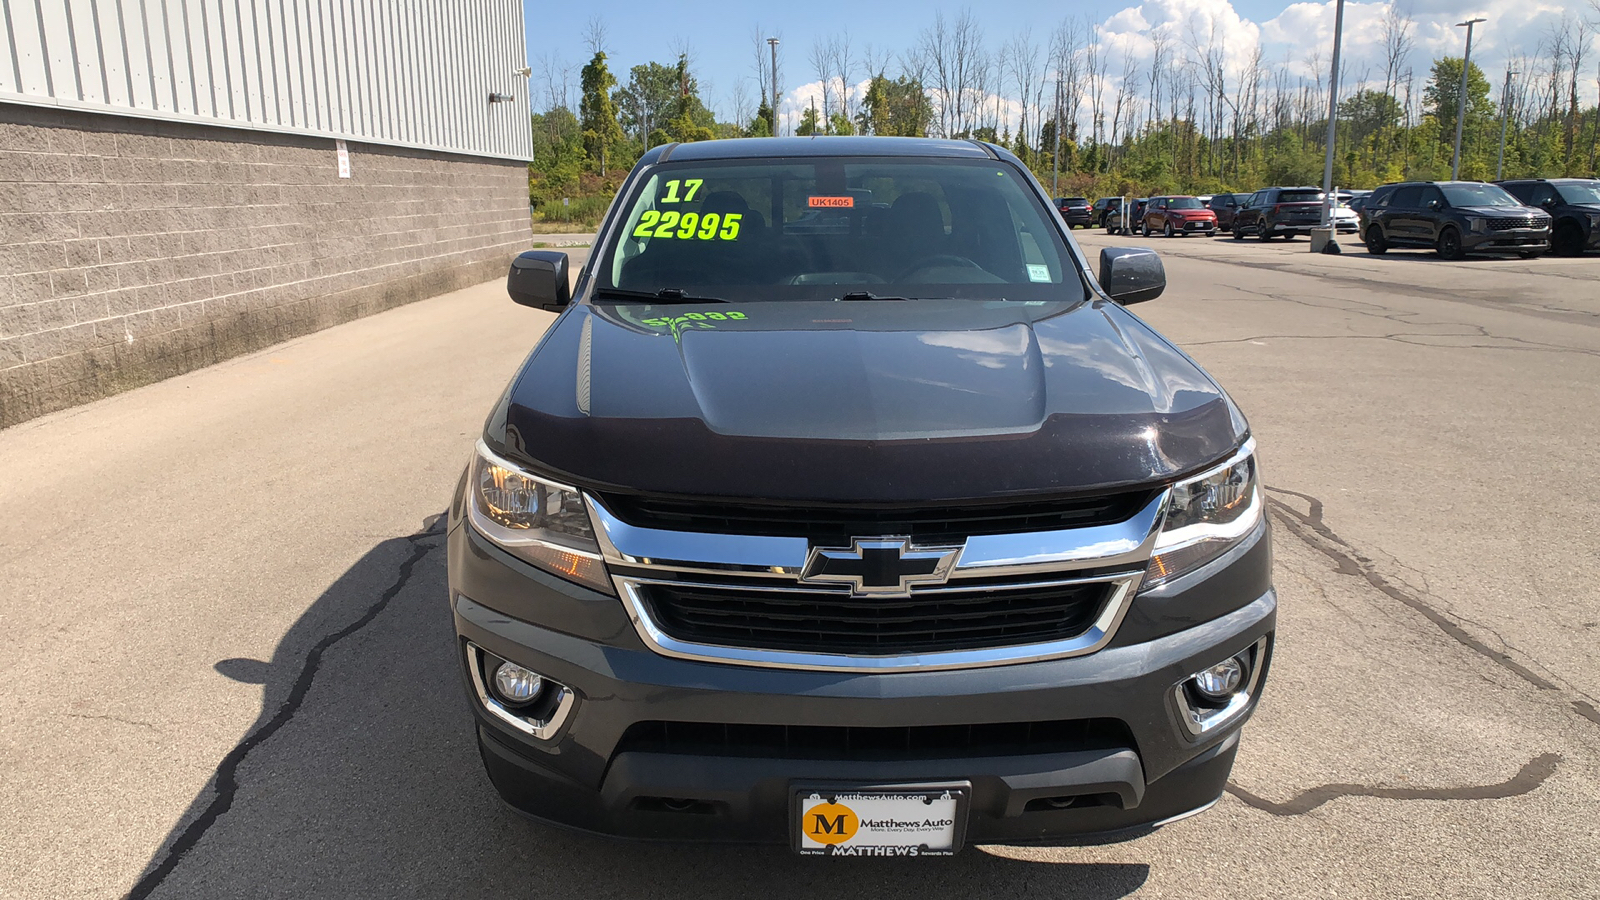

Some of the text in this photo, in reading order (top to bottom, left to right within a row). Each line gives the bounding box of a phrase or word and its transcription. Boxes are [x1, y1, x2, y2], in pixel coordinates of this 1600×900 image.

[661, 179, 703, 203] 17
[812, 198, 850, 207] UK1405
[633, 210, 743, 240] 22995
[811, 814, 848, 835] M
[860, 819, 953, 828] Matthews Auto
[831, 845, 918, 856] MATTHEWS
